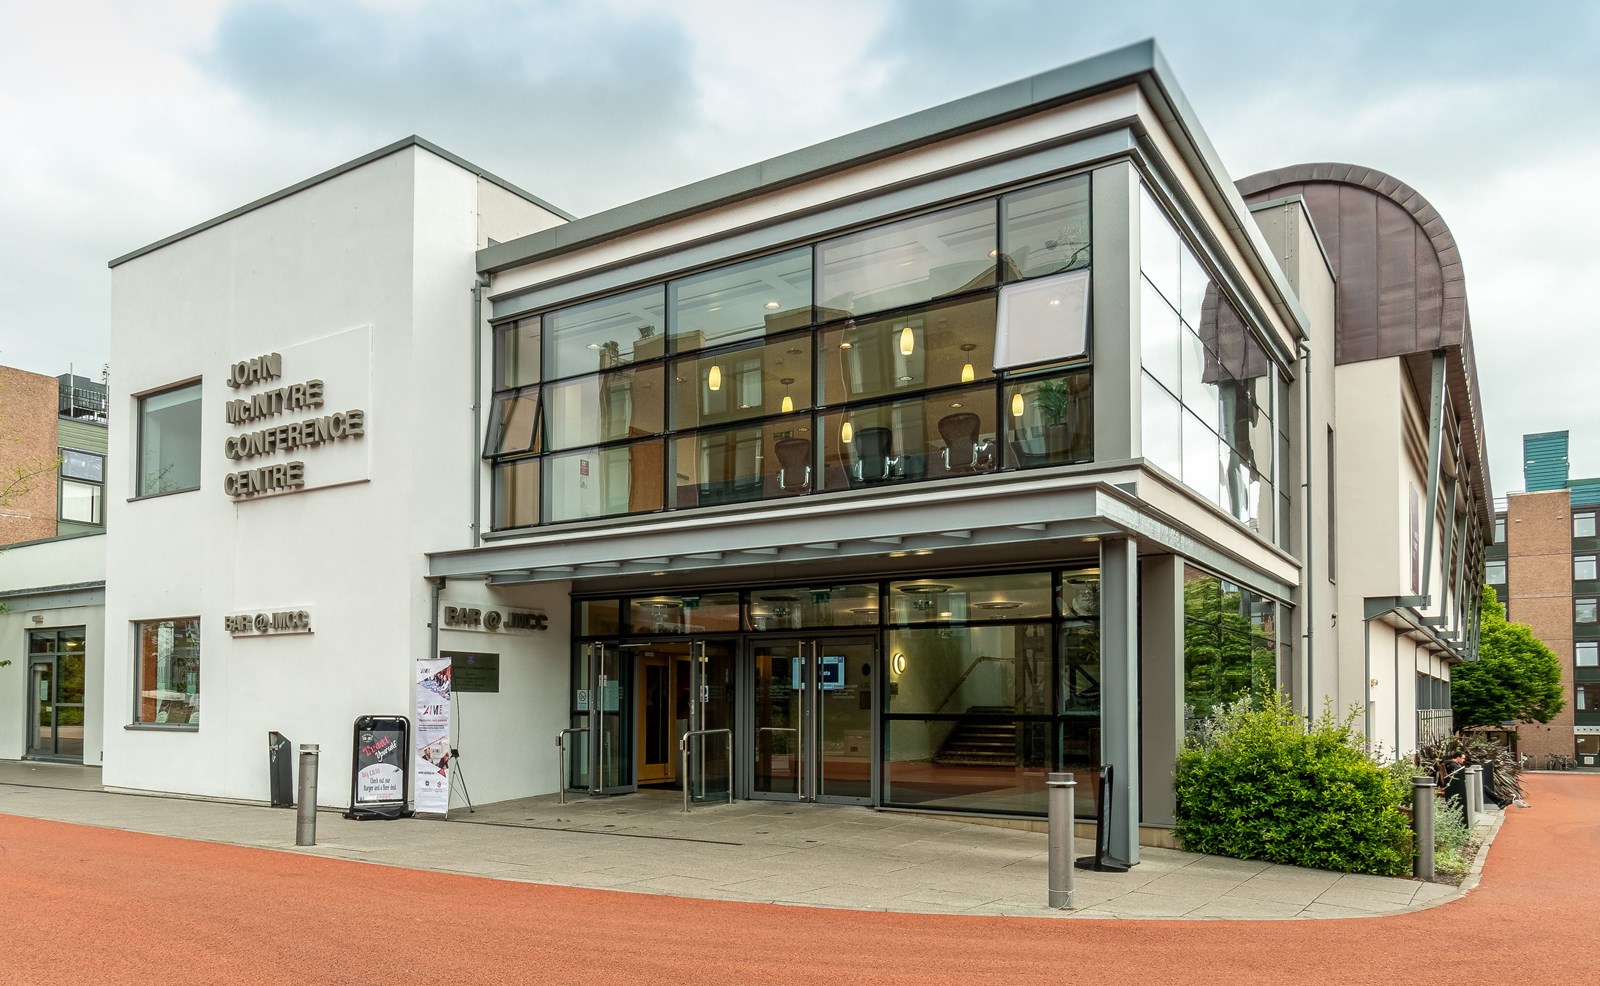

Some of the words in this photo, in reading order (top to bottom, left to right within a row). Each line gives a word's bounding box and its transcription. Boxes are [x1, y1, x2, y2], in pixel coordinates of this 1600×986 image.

[226, 352, 281, 389] JOHN
[225, 379, 324, 425] McINTYRE
[224, 409, 364, 460] CONFERENCE
[224, 461, 304, 497] CENTRE
[224, 614, 253, 633] BAR
[253, 612, 270, 633] @
[269, 610, 310, 630] JMCC
[444, 606, 481, 626] BAR
[482, 610, 502, 632] @
[503, 612, 548, 631] JMCC
[362, 736, 390, 756] Treat
[374, 740, 397, 762] Yourself
[364, 784, 374, 792] Burger
